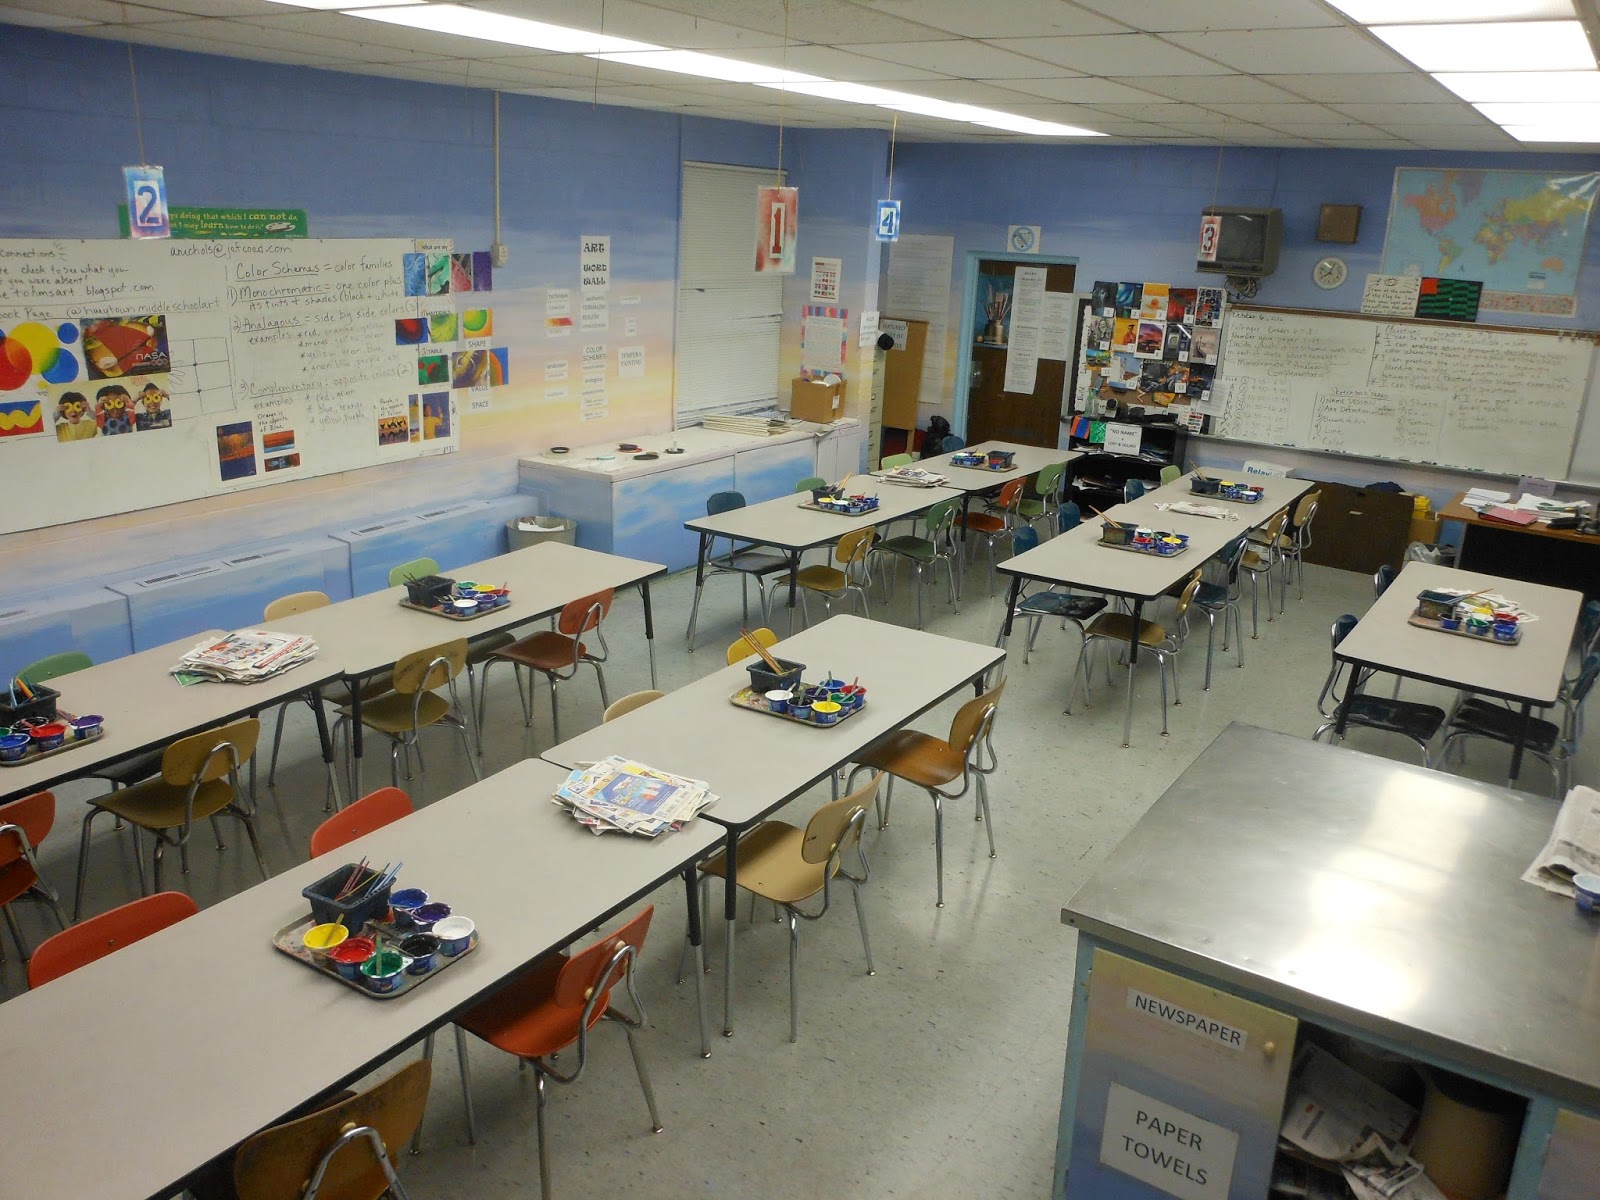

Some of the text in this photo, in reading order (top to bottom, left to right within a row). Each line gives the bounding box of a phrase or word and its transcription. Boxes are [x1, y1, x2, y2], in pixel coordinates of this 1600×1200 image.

[137, 185, 161, 223] 2
[180, 212, 201, 223] doing
[203, 212, 219, 221] that
[221, 213, 242, 221] which
[249, 212, 267, 221] can
[269, 212, 286, 221] not
[881, 211, 894, 234] 4
[200, 220, 224, 229] learn
[772, 207, 782, 254] 1
[1202, 226, 1215, 251] 3
[583, 242, 605, 253] ART
[21, 264, 45, 275] check
[51, 264, 62, 274] to
[80, 263, 105, 274] what
[108, 266, 129, 278] you
[236, 254, 393, 280] Color Schemes color families
[583, 263, 607, 273] WORD
[8, 279, 24, 289] you
[583, 276, 606, 286] WALL
[240, 283, 322, 301] Monochromatic
[336, 282, 352, 291] one
[358, 277, 381, 290] color
[384, 274, 402, 291] plus
[264, 297, 289, 309] tints
[305, 294, 338, 307] shades
[374, 289, 399, 302] white
[548, 292, 569, 300] technique
[24, 307, 51, 320] Page
[314, 312, 335, 323] side
[339, 309, 354, 325] by
[356, 306, 375, 319] side
[1231, 312, 1259, 321] October
[249, 330, 292, 346] examples
[1231, 331, 1256, 340] Number
[468, 339, 487, 348] SHAPE
[585, 345, 604, 354] COLOR
[582, 352, 607, 362] SCHEMES
[620, 351, 642, 360] TEMPERA
[620, 359, 641, 367] PAINTING
[250, 378, 323, 396] Complementary
[333, 373, 369, 389] opposite
[471, 385, 489, 393] VALUE
[253, 395, 295, 410] examples
[472, 400, 489, 409] SPACE
[1325, 397, 1345, 405] NAME
[1348, 398, 1376, 406] DESIGN
[257, 412, 277, 422] Orange
[258, 419, 268, 427] the
[260, 423, 284, 434] of Blue
[1322, 435, 1344, 446] Color
[1134, 994, 1241, 1047] NEWSPAPER
[1135, 1109, 1203, 1152] PAPER
[1121, 1134, 1208, 1186] TOWELS
